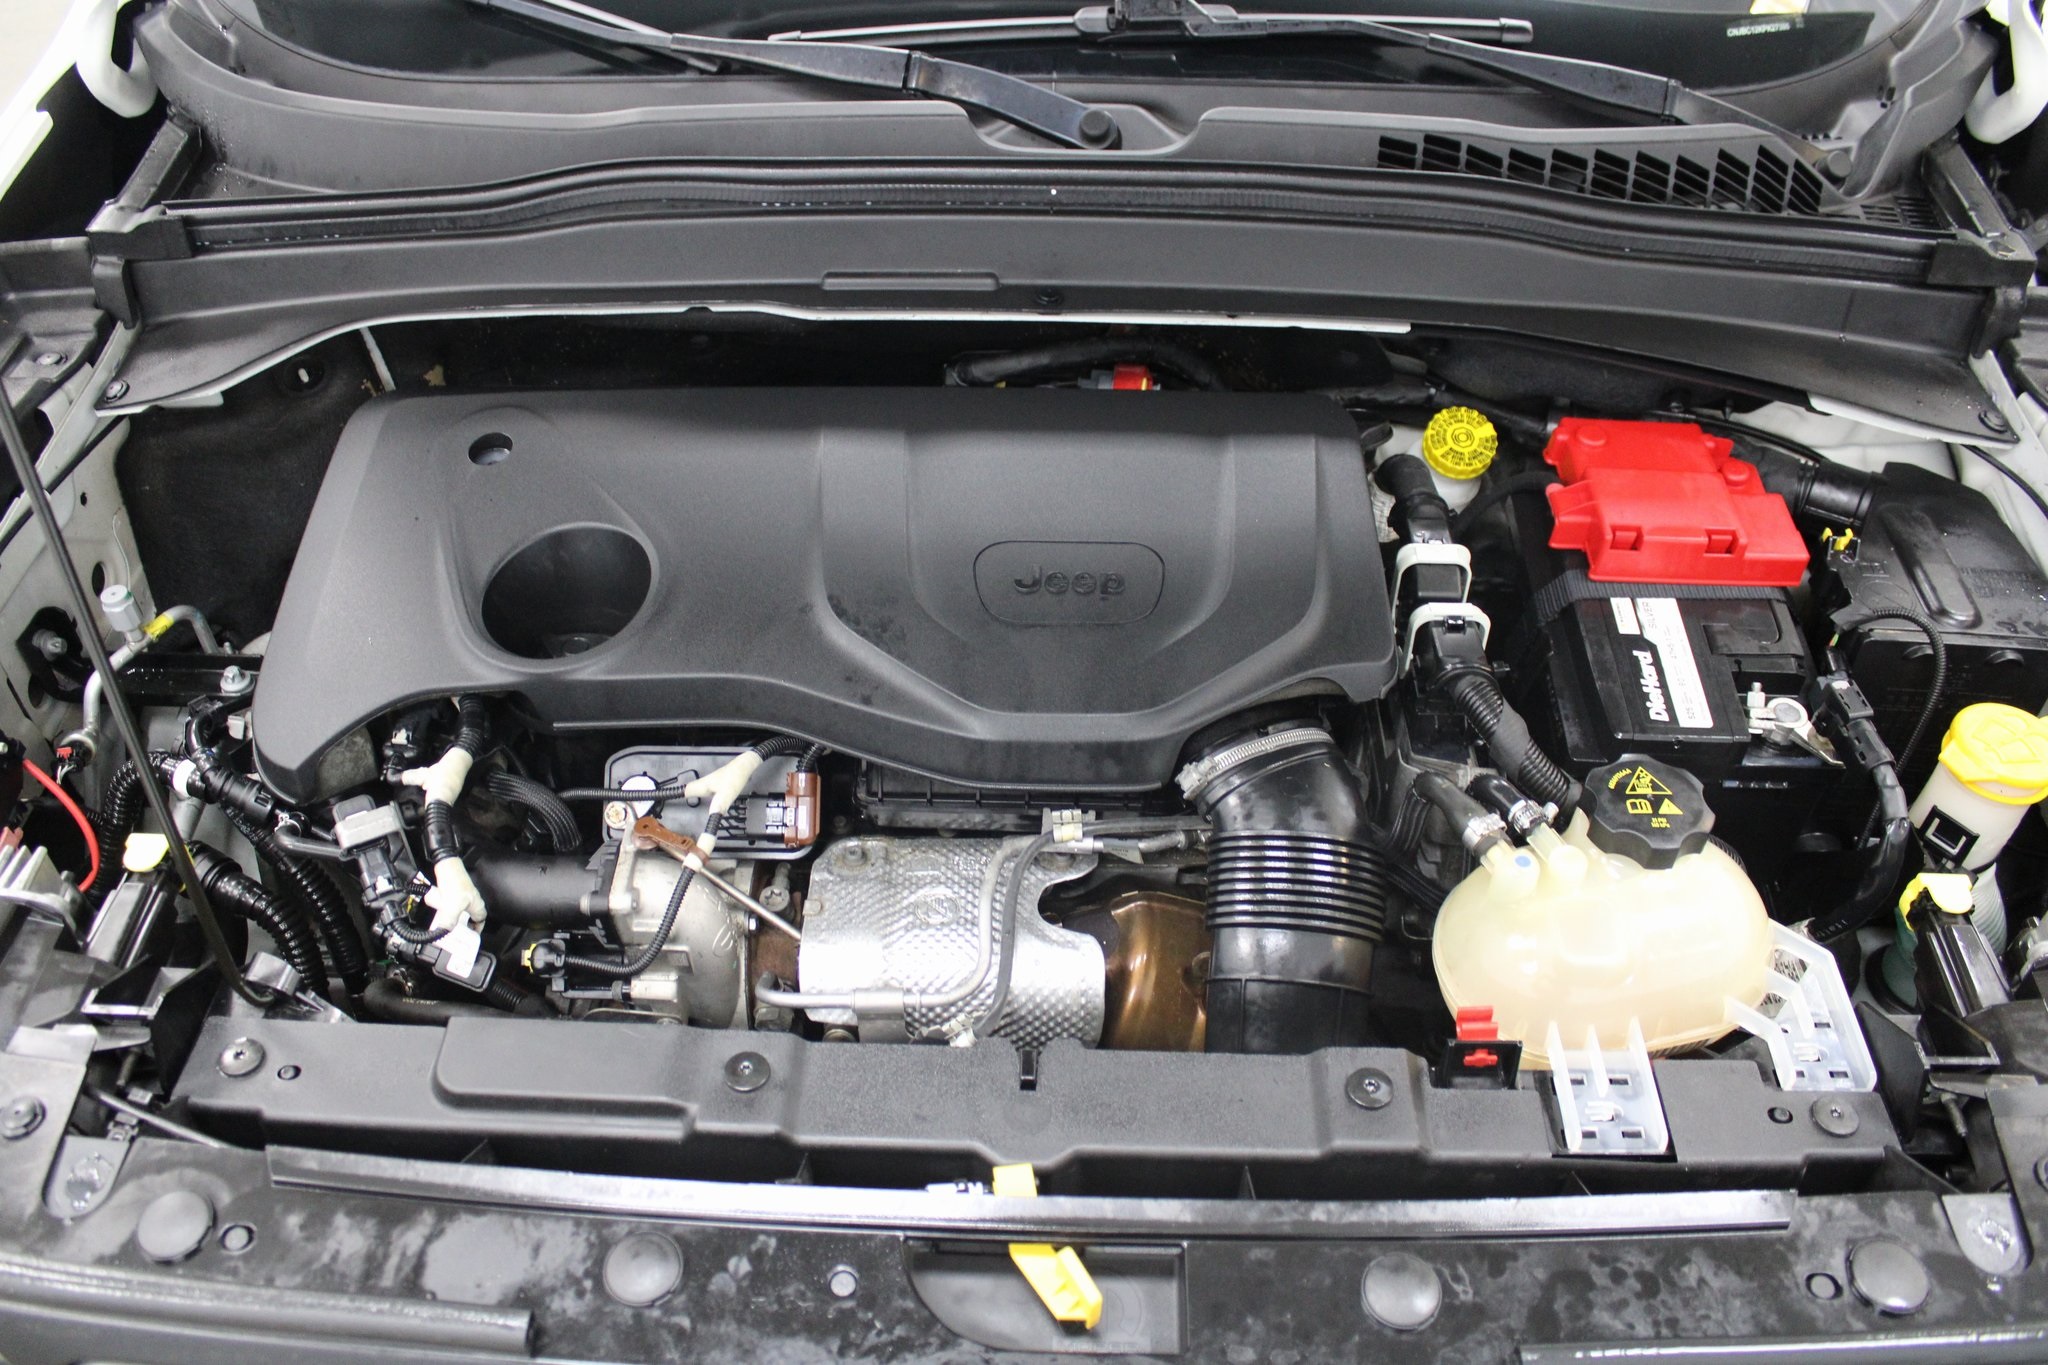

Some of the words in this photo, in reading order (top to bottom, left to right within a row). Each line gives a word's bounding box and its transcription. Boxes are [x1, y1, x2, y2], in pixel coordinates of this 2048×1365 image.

[1013, 564, 1127, 600] Jeep
[1641, 601, 1658, 629] SILVER
[1631, 649, 1670, 722] DieHard
